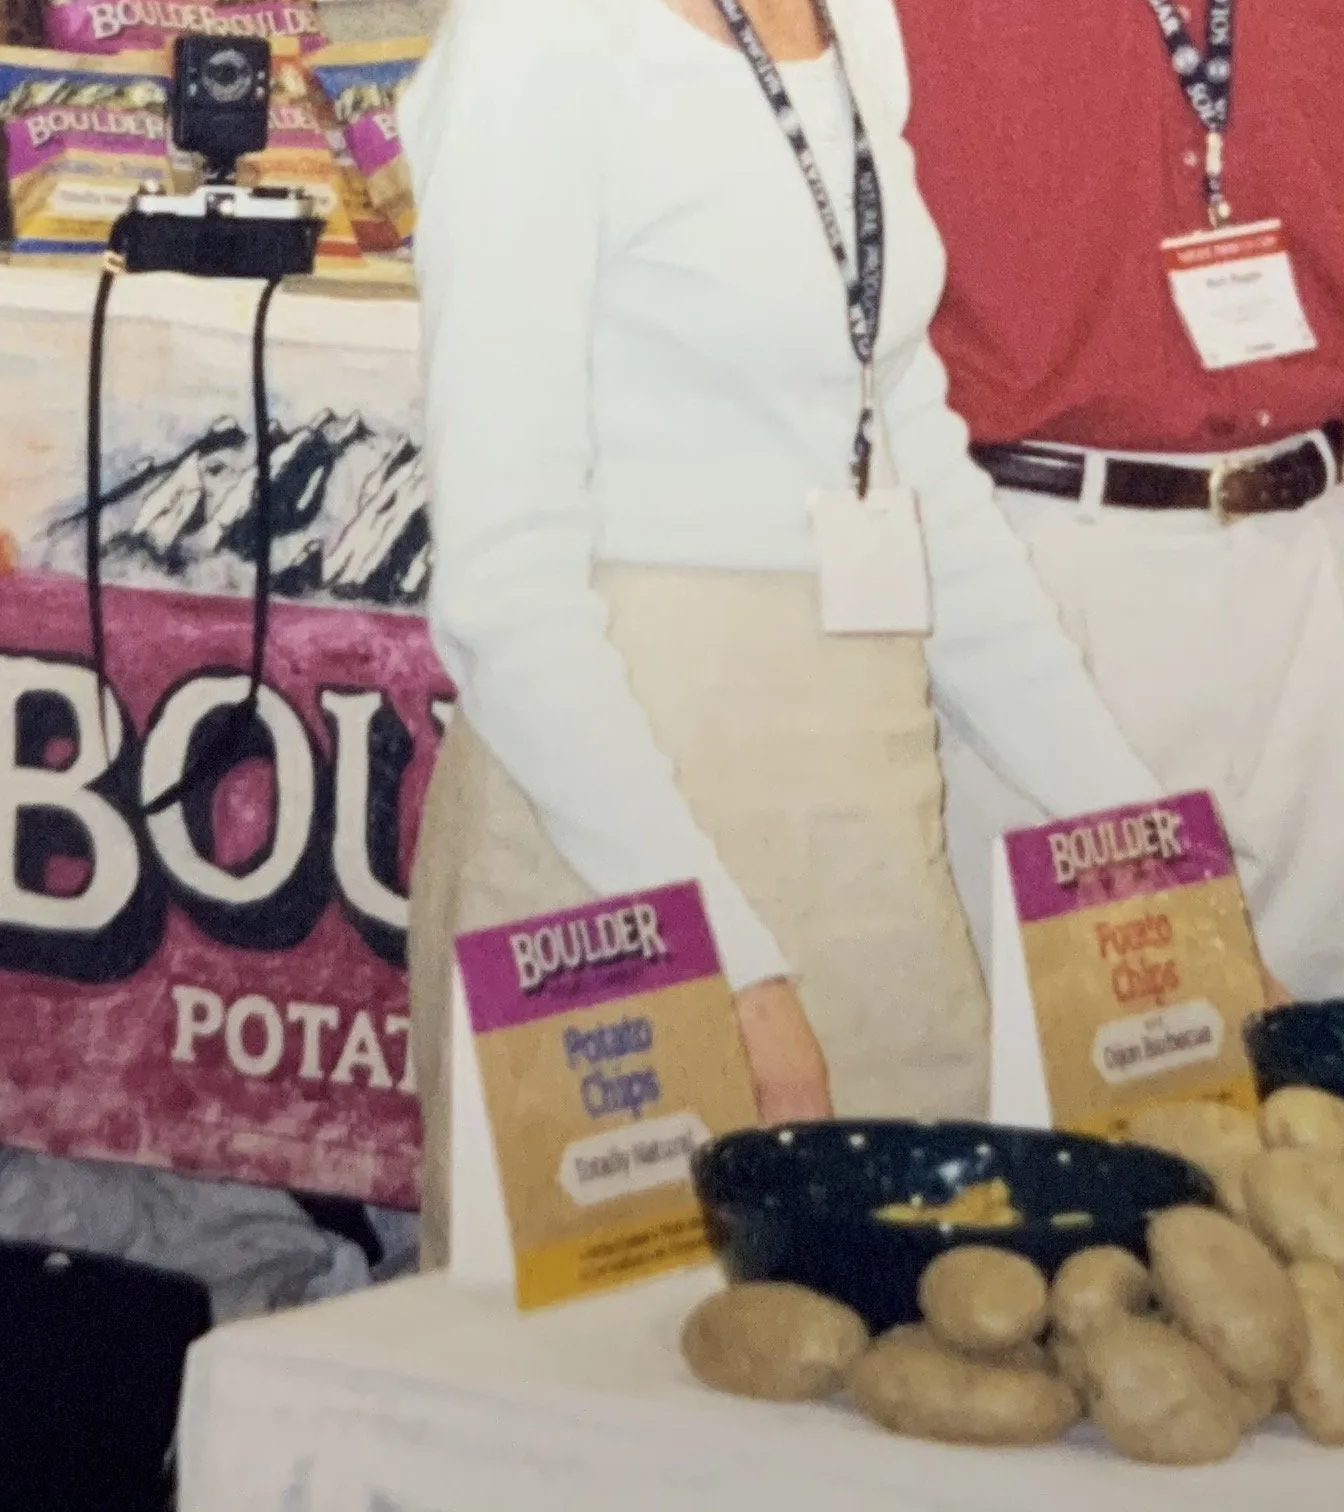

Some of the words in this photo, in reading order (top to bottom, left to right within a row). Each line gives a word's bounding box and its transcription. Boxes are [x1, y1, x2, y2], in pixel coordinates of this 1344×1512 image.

[1048, 807, 1183, 886] BOULDER
[509, 904, 667, 991] BOULDER
[580, 1066, 662, 1121] Chips
